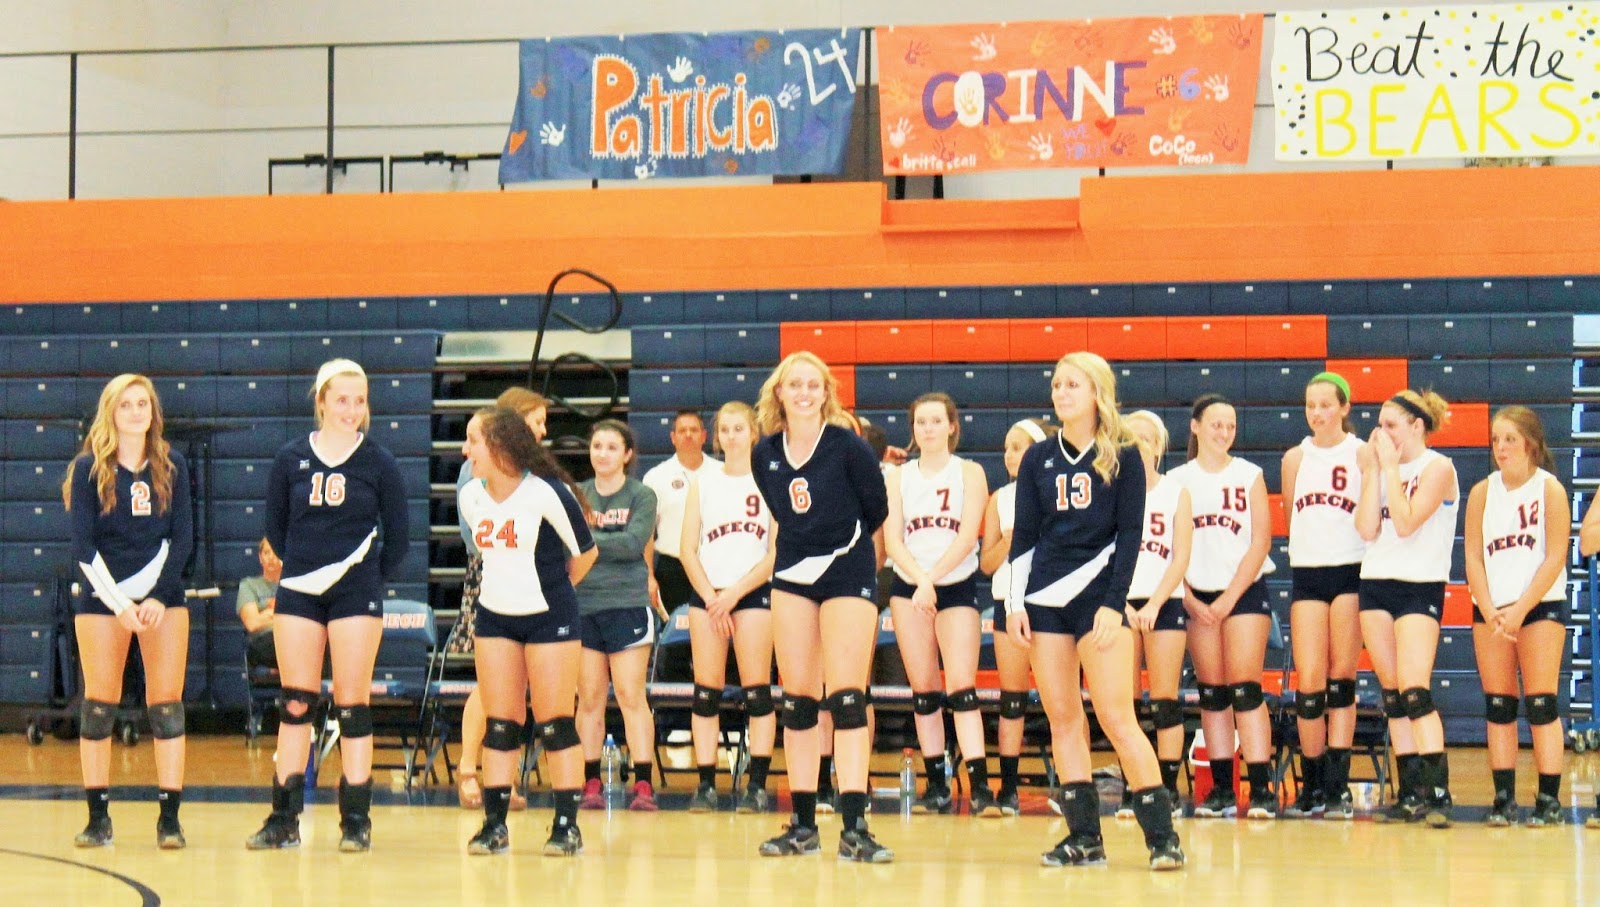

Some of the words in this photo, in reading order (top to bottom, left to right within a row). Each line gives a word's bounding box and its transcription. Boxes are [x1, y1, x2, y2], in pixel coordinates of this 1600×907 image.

[1294, 20, 1434, 82] Beat
[1481, 21, 1574, 82] the
[784, 39, 856, 105] 24
[1156, 68, 1201, 100] #6
[591, 54, 779, 160] Patricia
[922, 60, 1147, 130] CORINNE
[1315, 80, 1582, 157] BEARS
[309, 472, 346, 506] 16
[1055, 472, 1092, 511] 13
[1331, 465, 1348, 491] 6
[130, 481, 151, 516] 2
[745, 494, 761, 517] 9
[789, 477, 812, 514] 6
[936, 487, 951, 511] 7
[1221, 487, 1247, 512] 15
[1295, 493, 1357, 514] BEECH
[1150, 513, 1165, 536] 5
[1192, 514, 1242, 535] EECH
[1518, 500, 1539, 530] 12
[475, 519, 518, 548] 24
[706, 521, 767, 543] BEECH
